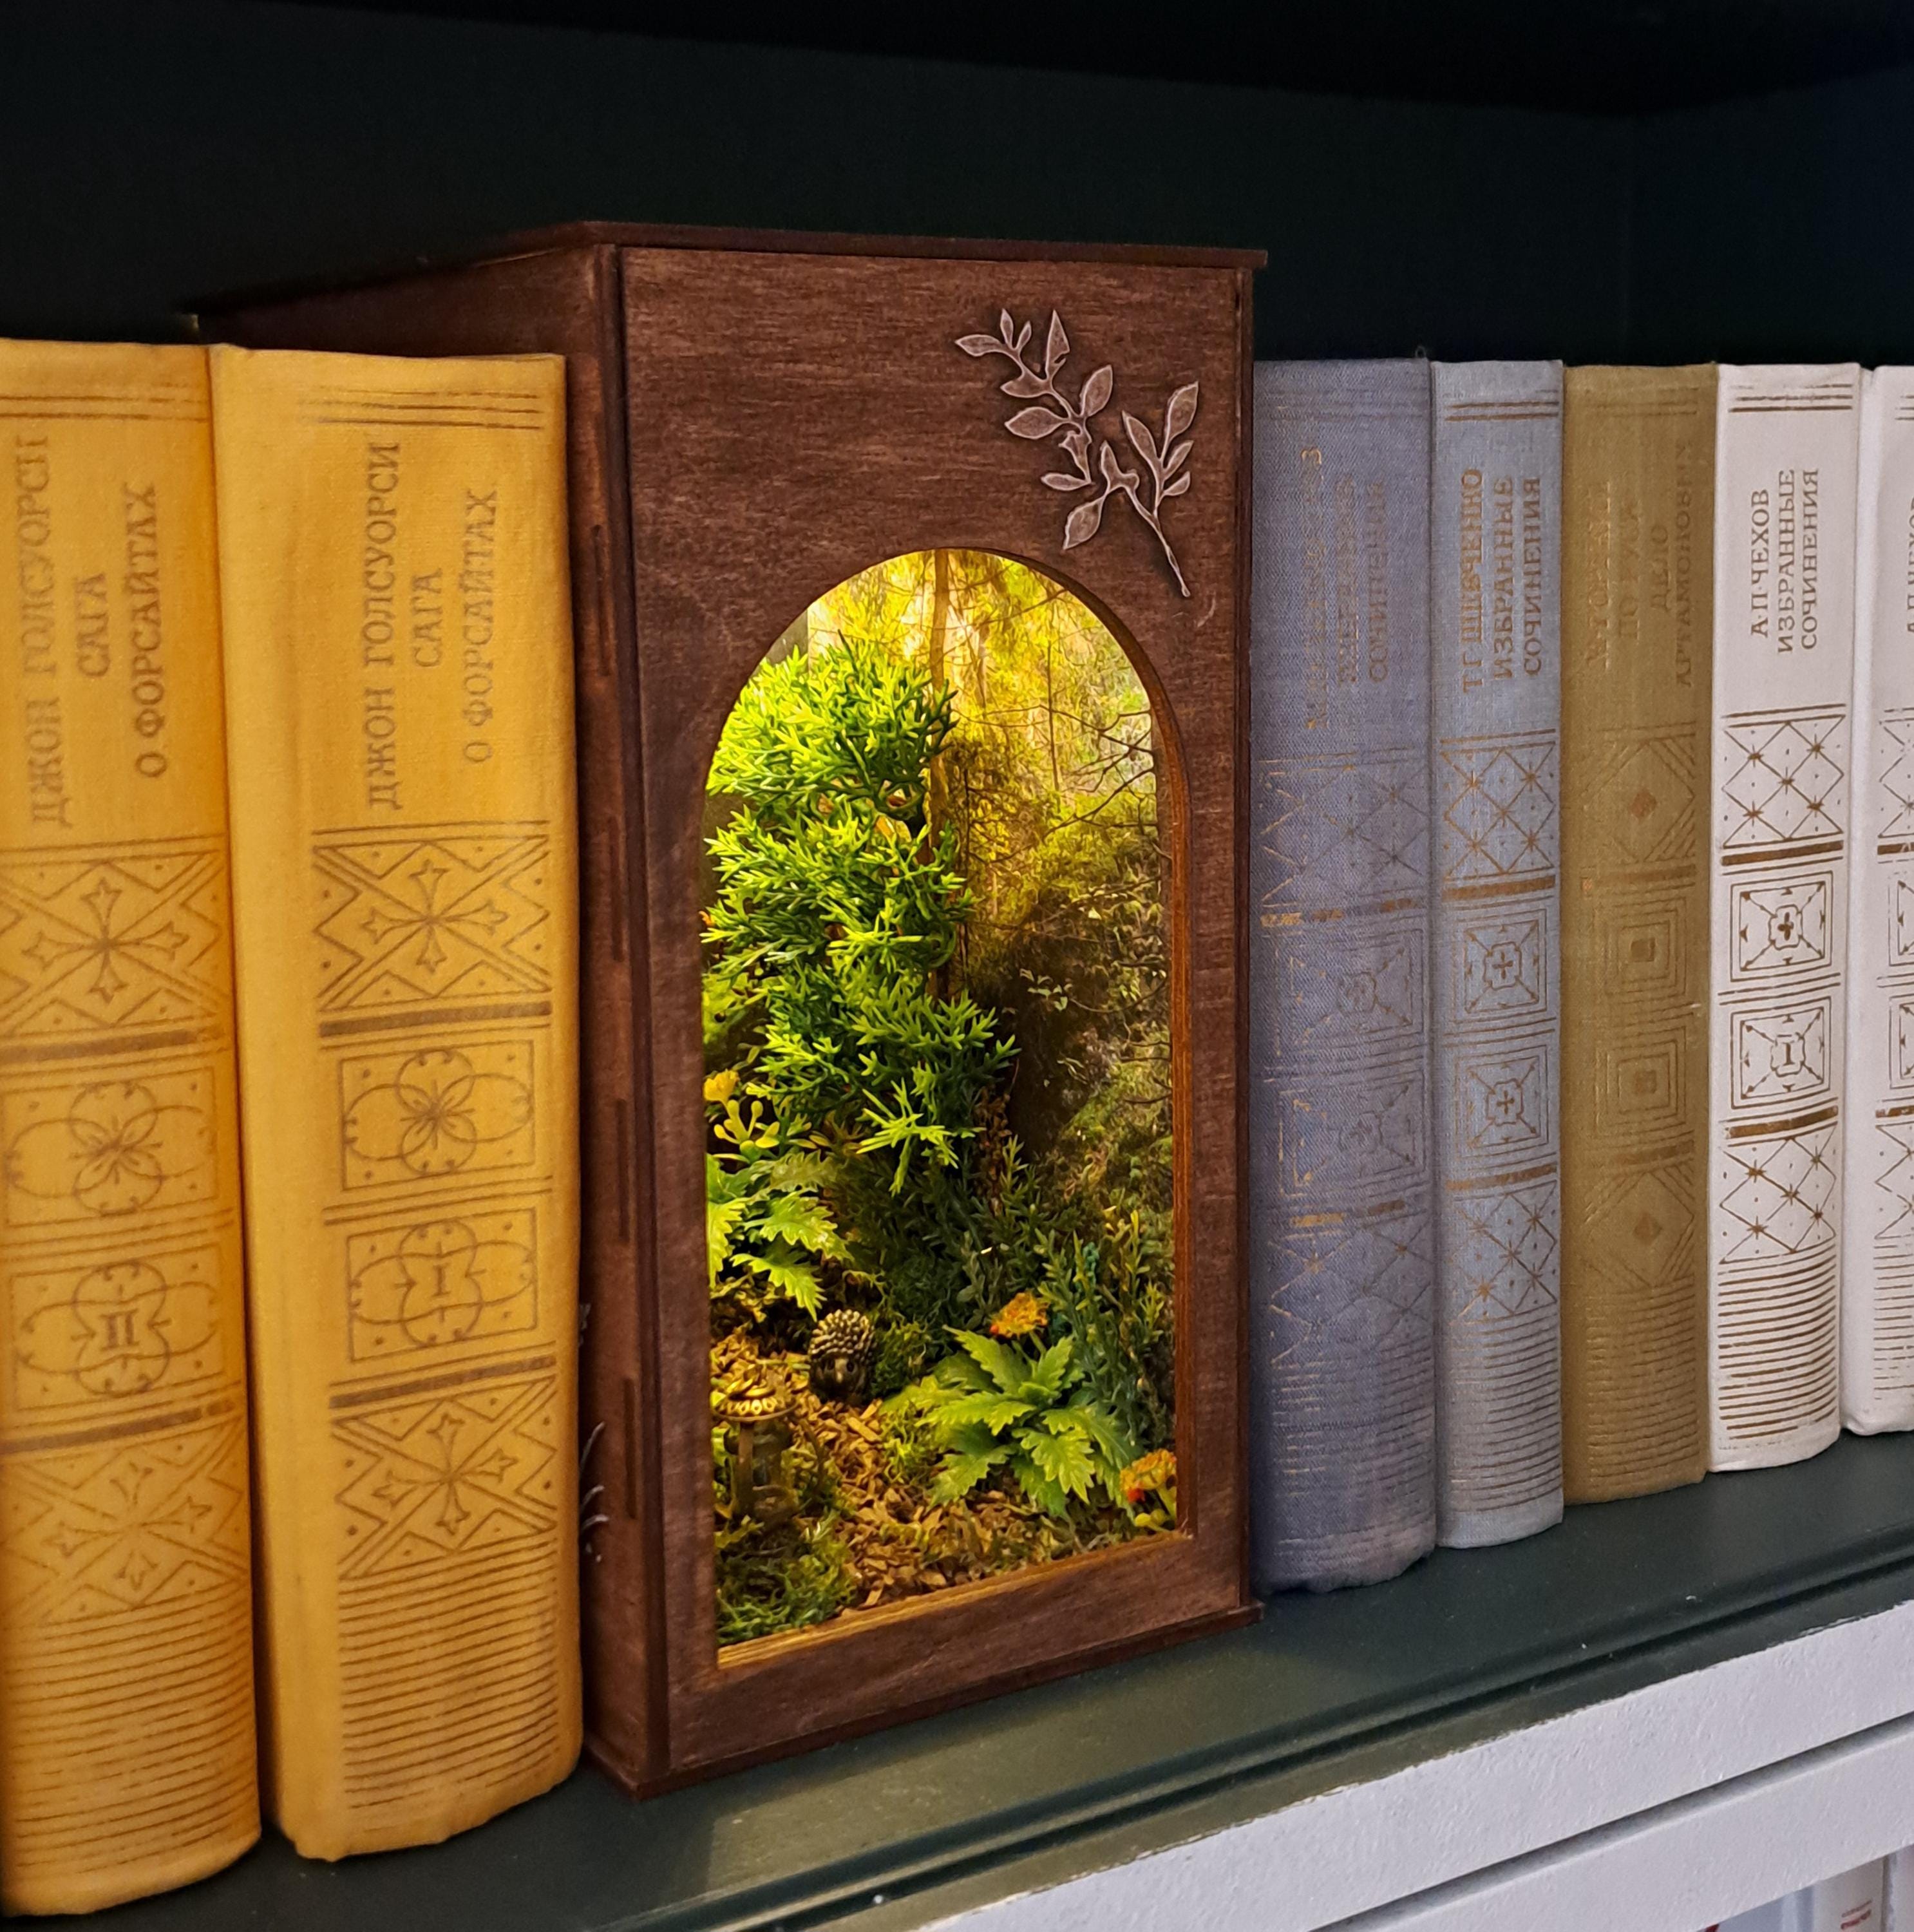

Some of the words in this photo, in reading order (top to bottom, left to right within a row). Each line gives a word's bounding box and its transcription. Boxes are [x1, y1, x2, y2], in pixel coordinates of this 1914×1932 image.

[71, 571, 111, 678] САГА
[121, 481, 166, 739] ФОРСАЙТАХ
[361, 441, 400, 668] ГОЛСУОРСИ
[409, 567, 444, 668] САГА
[457, 488, 497, 728] ФОРСАЙТАХ
[1459, 468, 1483, 643] ШЕВЧЕНКО
[1493, 476, 1514, 680] ИЗБРАННЫЕ
[1522, 477, 1542, 676] СОЧИНЕНИЯ
[1649, 523, 1671, 612] ДЕЛО
[1777, 469, 1795, 654] ИЗБРАННЫЕ
[1801, 469, 1819, 650] СОЧИНЕНИЯ
[24, 697, 73, 830] ДЖОН
[134, 751, 167, 779] О
[363, 686, 403, 811] ДЖОН
[460, 741, 493, 764] О
